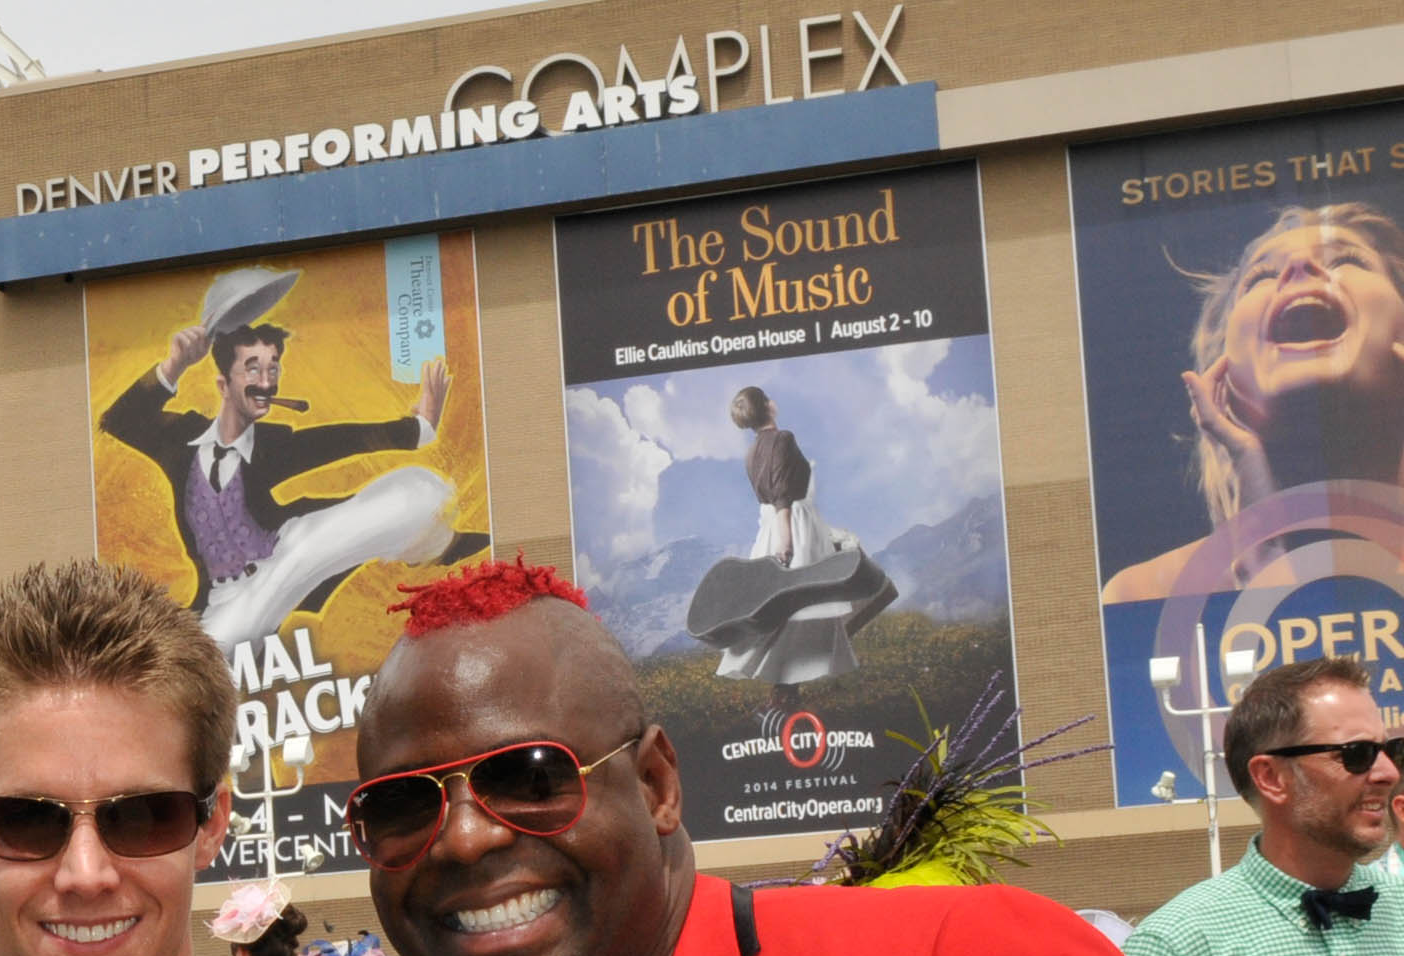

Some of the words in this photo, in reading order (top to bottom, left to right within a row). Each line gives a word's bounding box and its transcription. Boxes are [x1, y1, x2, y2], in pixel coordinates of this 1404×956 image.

[445, 4, 909, 137] COMPLEX
[16, 160, 178, 217] DENVER
[189, 100, 540, 187] PERFORMING
[562, 75, 700, 131] ARTS
[1122, 161, 1276, 205] STORIES
[1287, 147, 1376, 181] THAT
[632, 218, 725, 276] The
[740, 188, 900, 263] Sound
[410, 255, 424, 317] Theatre
[666, 269, 718, 327] of
[726, 262, 873, 322] Music
[396, 293, 412, 366] Company
[615, 347, 646, 366] Ellie
[648, 340, 708, 362] Caulkins
[711, 334, 756, 356] Opera
[758, 328, 806, 350] House
[831, 315, 886, 341] August
[889, 313, 901, 332] 2
[914, 309, 933, 329] 10
[236, 675, 377, 756] RACK
[722, 735, 784, 761] CENTRAL
[790, 732, 823, 749] CITY
[826, 731, 875, 748] OPERA
[724, 797, 884, 823] CentralCityOpera.org
[744, 781, 778, 793] 2014
[786, 774, 858, 790] FESTIVAL
